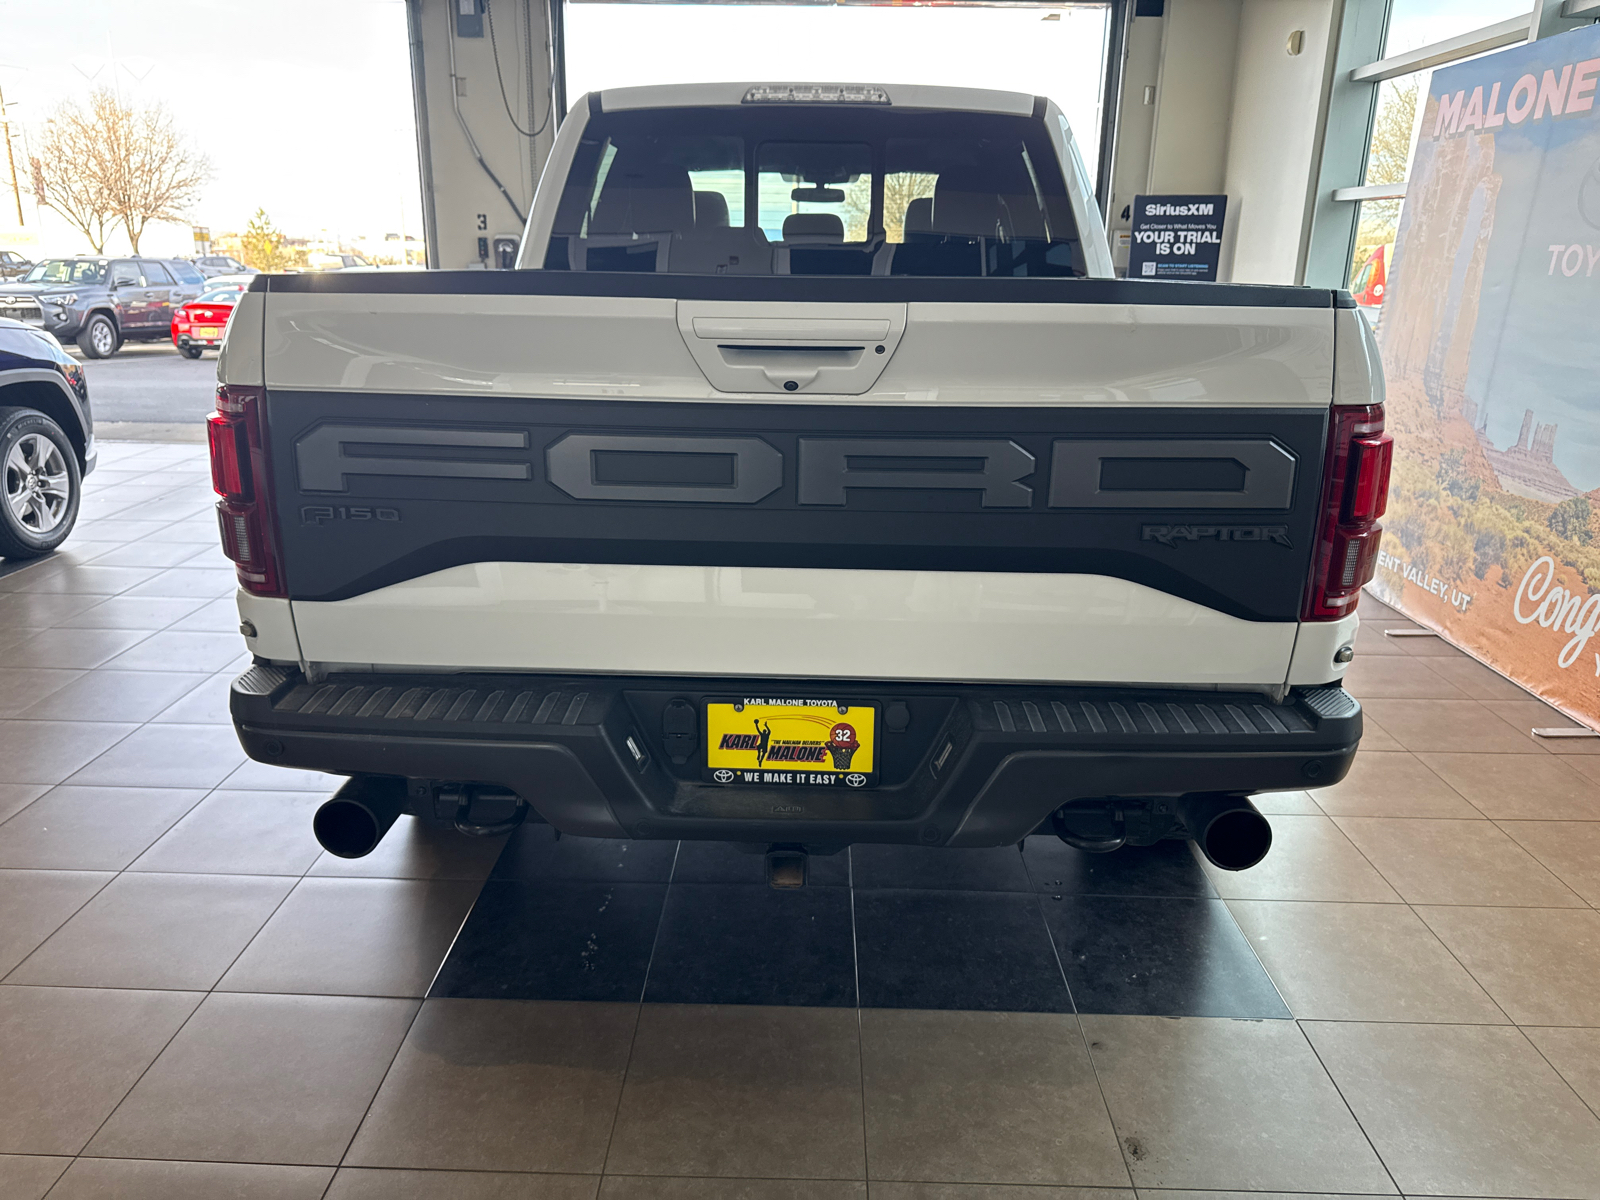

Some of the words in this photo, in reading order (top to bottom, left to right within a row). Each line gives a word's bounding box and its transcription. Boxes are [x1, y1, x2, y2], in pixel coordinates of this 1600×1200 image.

[1433, 57, 1600, 138] MALONE
[1120, 204, 1131, 222] 4
[1145, 203, 1214, 216] SiriusXM
[477, 213, 487, 231] 3
[1134, 231, 1175, 244] YOUR
[1177, 231, 1221, 244] TRIAL
[1155, 243, 1171, 255] IS
[1173, 243, 1196, 255] ON
[295, 420, 1296, 510] FORD
[1140, 523, 1293, 550] RAPTOR
[1377, 549, 1401, 573] ENT
[1402, 563, 1449, 603] VALLEY,
[1451, 588, 1471, 611] UT
[1513, 556, 1600, 668] Cong
[743, 698, 767, 706] KARL
[768, 699, 804, 707] MALONE
[805, 700, 838, 708] TOYOTA
[719, 733, 760, 751] KARL
[834, 729, 851, 742] 32
[766, 745, 828, 763] MALONE
[743, 772, 760, 783] WE
[763, 772, 794, 783] MAKE
[796, 773, 807, 784] IT
[809, 774, 837, 785] EASY
